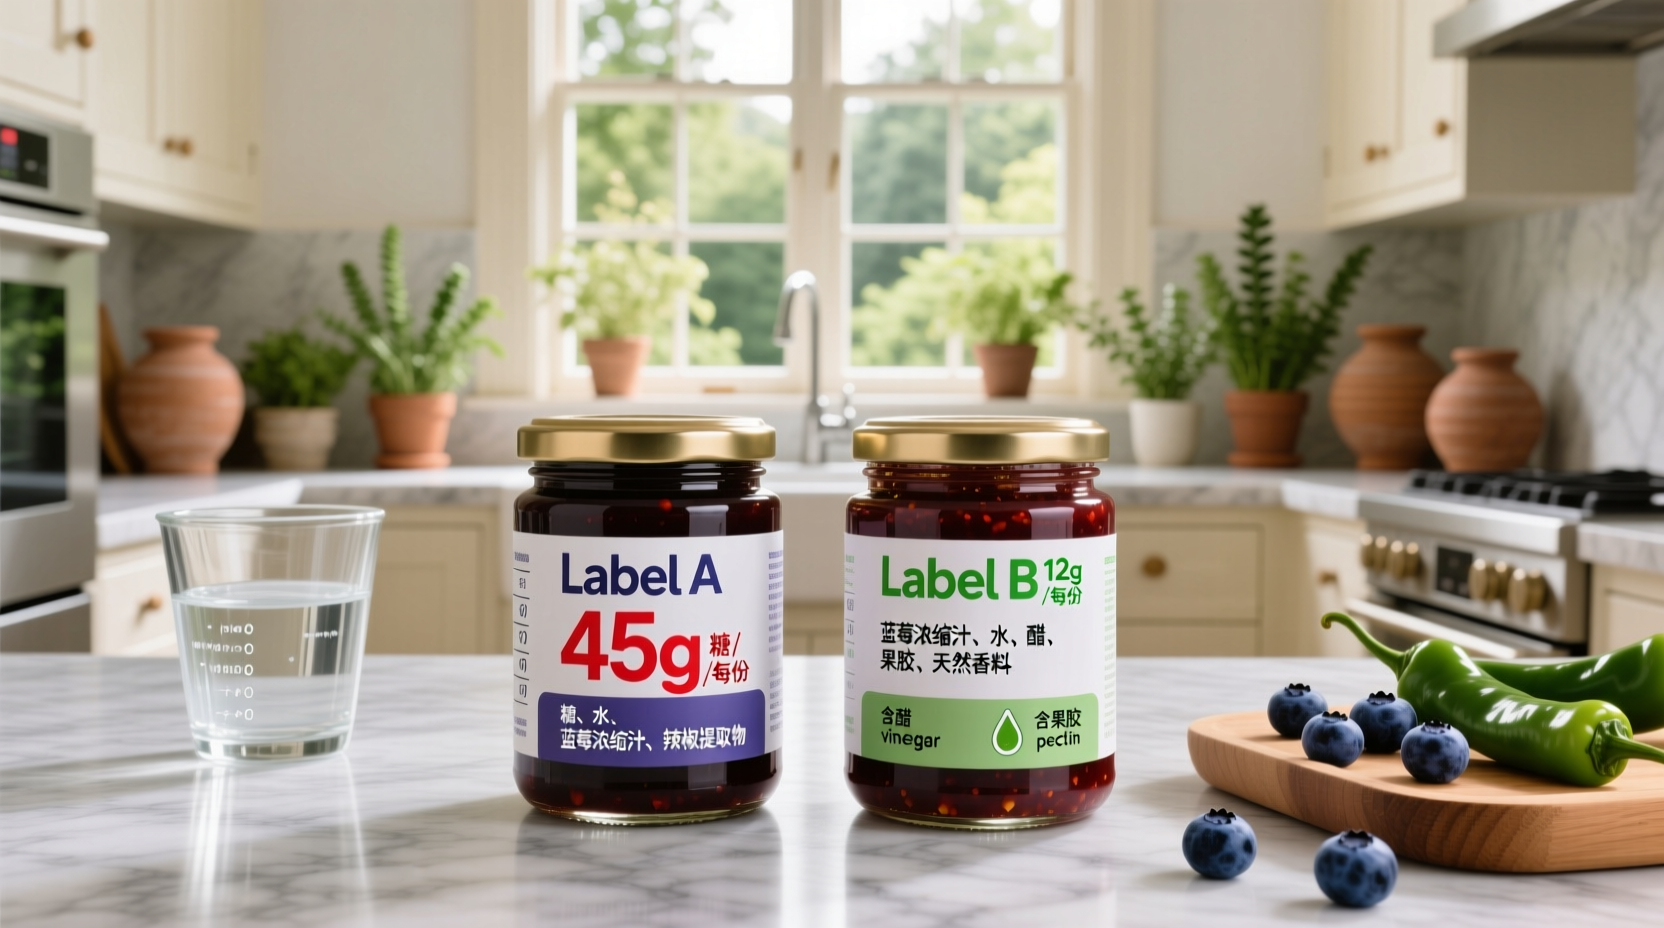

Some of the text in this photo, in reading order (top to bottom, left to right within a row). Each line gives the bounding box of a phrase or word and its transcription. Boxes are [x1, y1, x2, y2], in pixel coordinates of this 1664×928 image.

[561, 552, 723, 596] Label A
[881, 555, 999, 600] Label
[1009, 558, 1039, 600] B
[1043, 557, 1082, 585] 12g
[560, 610, 701, 695] 45g
[1034, 707, 1082, 730] 含果胶
[881, 728, 941, 752] vinegar
[1037, 730, 1080, 753] pectin
